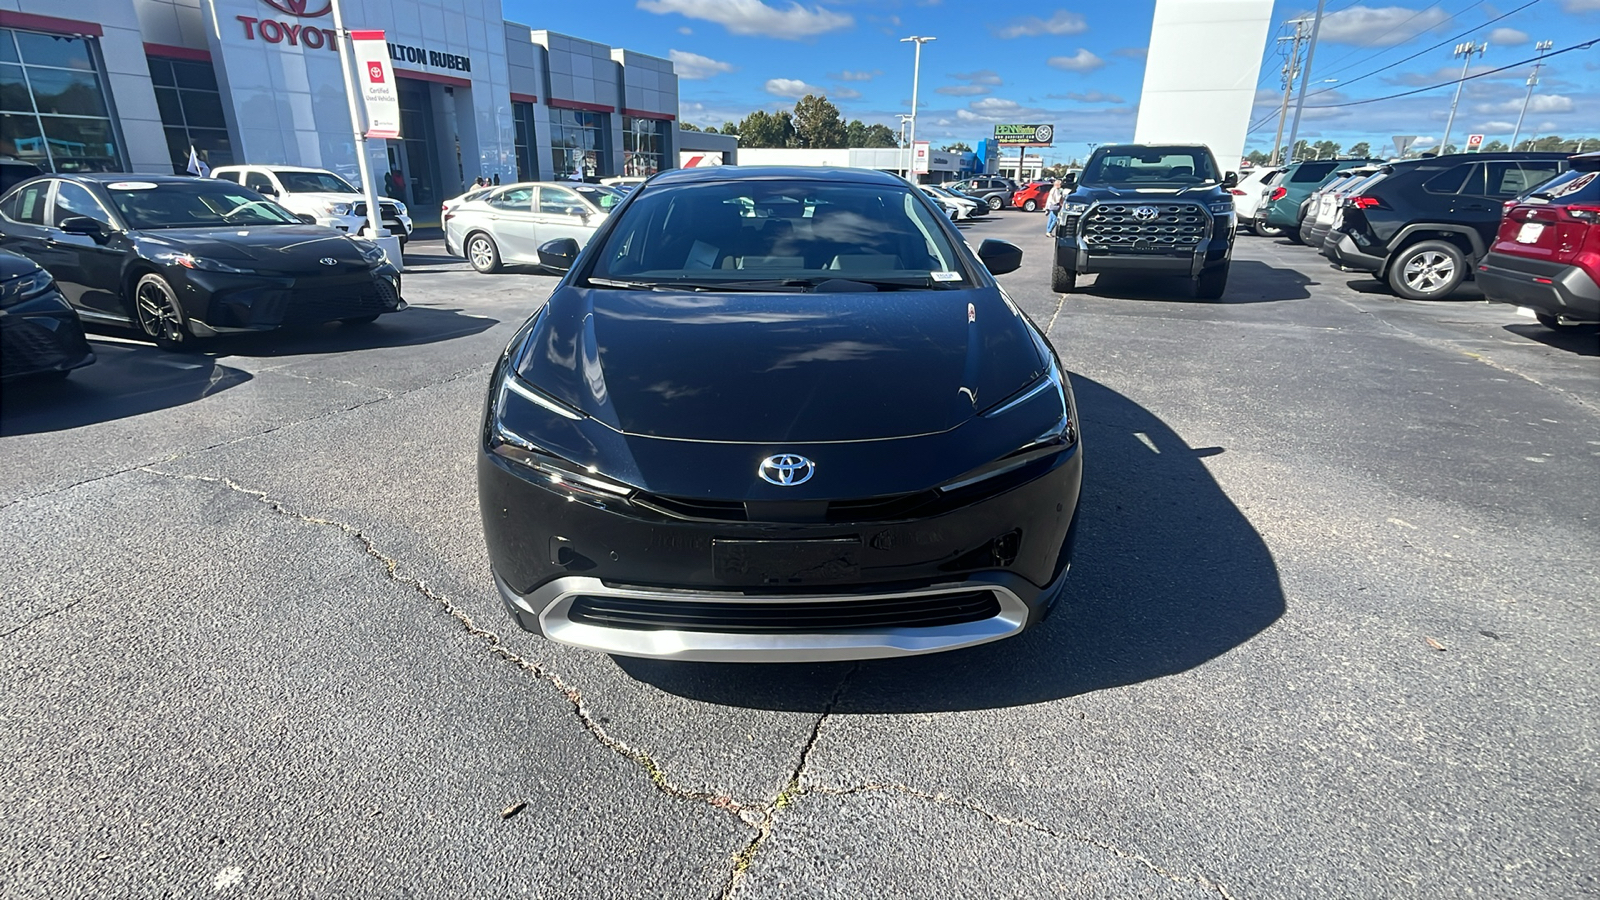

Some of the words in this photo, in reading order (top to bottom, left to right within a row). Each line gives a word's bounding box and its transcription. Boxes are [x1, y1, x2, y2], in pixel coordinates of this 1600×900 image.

[237, 15, 338, 52] TOYOT
[387, 42, 428, 65] ILTON
[429, 50, 471, 73] RUBEN
